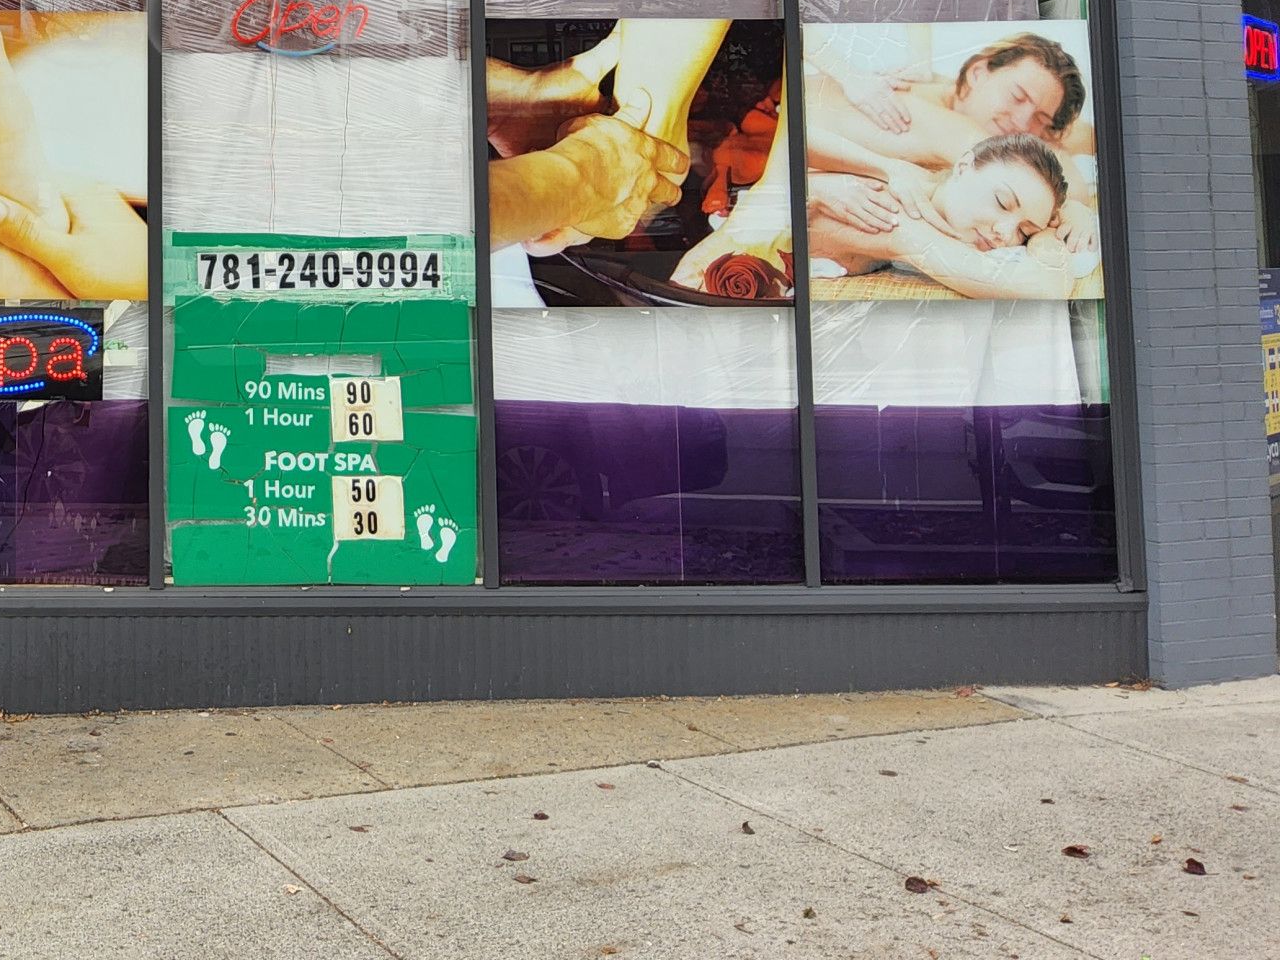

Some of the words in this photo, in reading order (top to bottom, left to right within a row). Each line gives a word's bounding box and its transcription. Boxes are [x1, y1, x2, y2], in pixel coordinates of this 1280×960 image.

[1243, 25, 1278, 70] OPEN
[199, 252, 441, 290] 781-240-9994
[244, 381, 271, 400] 90
[278, 382, 326, 401] Mins
[346, 381, 372, 404] 90
[245, 409, 254, 426] 1
[264, 409, 313, 427] Hour
[348, 413, 373, 437] 60
[265, 451, 329, 472] FOOT
[334, 452, 377, 472] SPA
[244, 480, 254, 499] 1
[265, 480, 315, 499] Hour
[351, 479, 376, 503] 50
[244, 507, 272, 526] 30
[278, 508, 326, 527] Mins
[353, 511, 378, 535] 30
